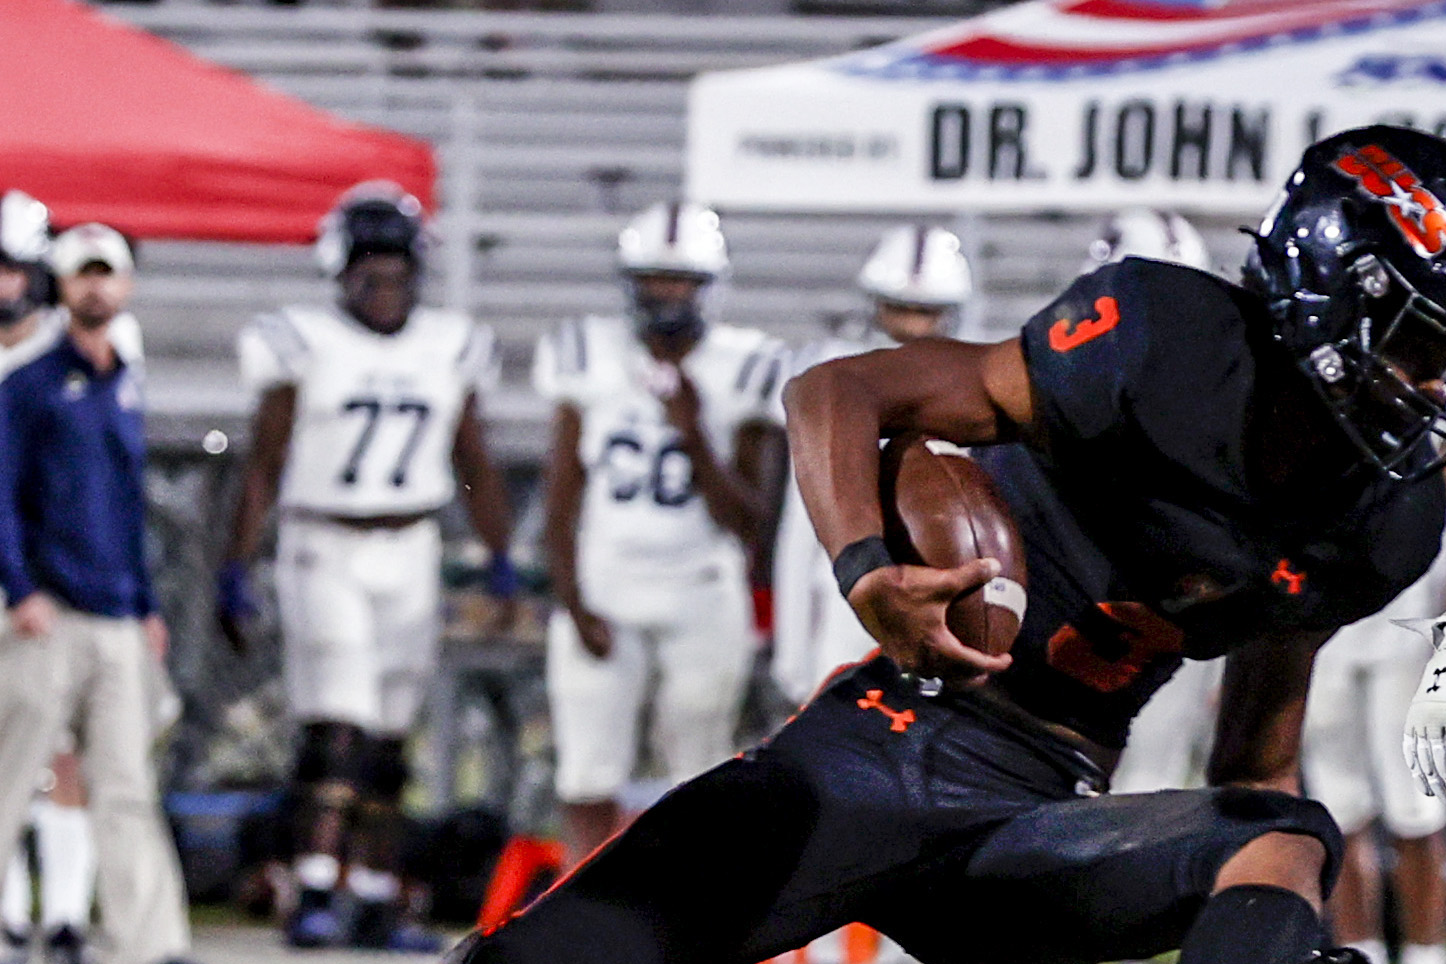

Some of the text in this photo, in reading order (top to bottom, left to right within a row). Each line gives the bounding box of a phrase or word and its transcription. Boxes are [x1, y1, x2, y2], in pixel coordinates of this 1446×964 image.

[931, 103, 1046, 179] DR.
[1072, 101, 1266, 181] JOHN
[1048, 296, 1121, 353] 3
[342, 396, 430, 489] 77
